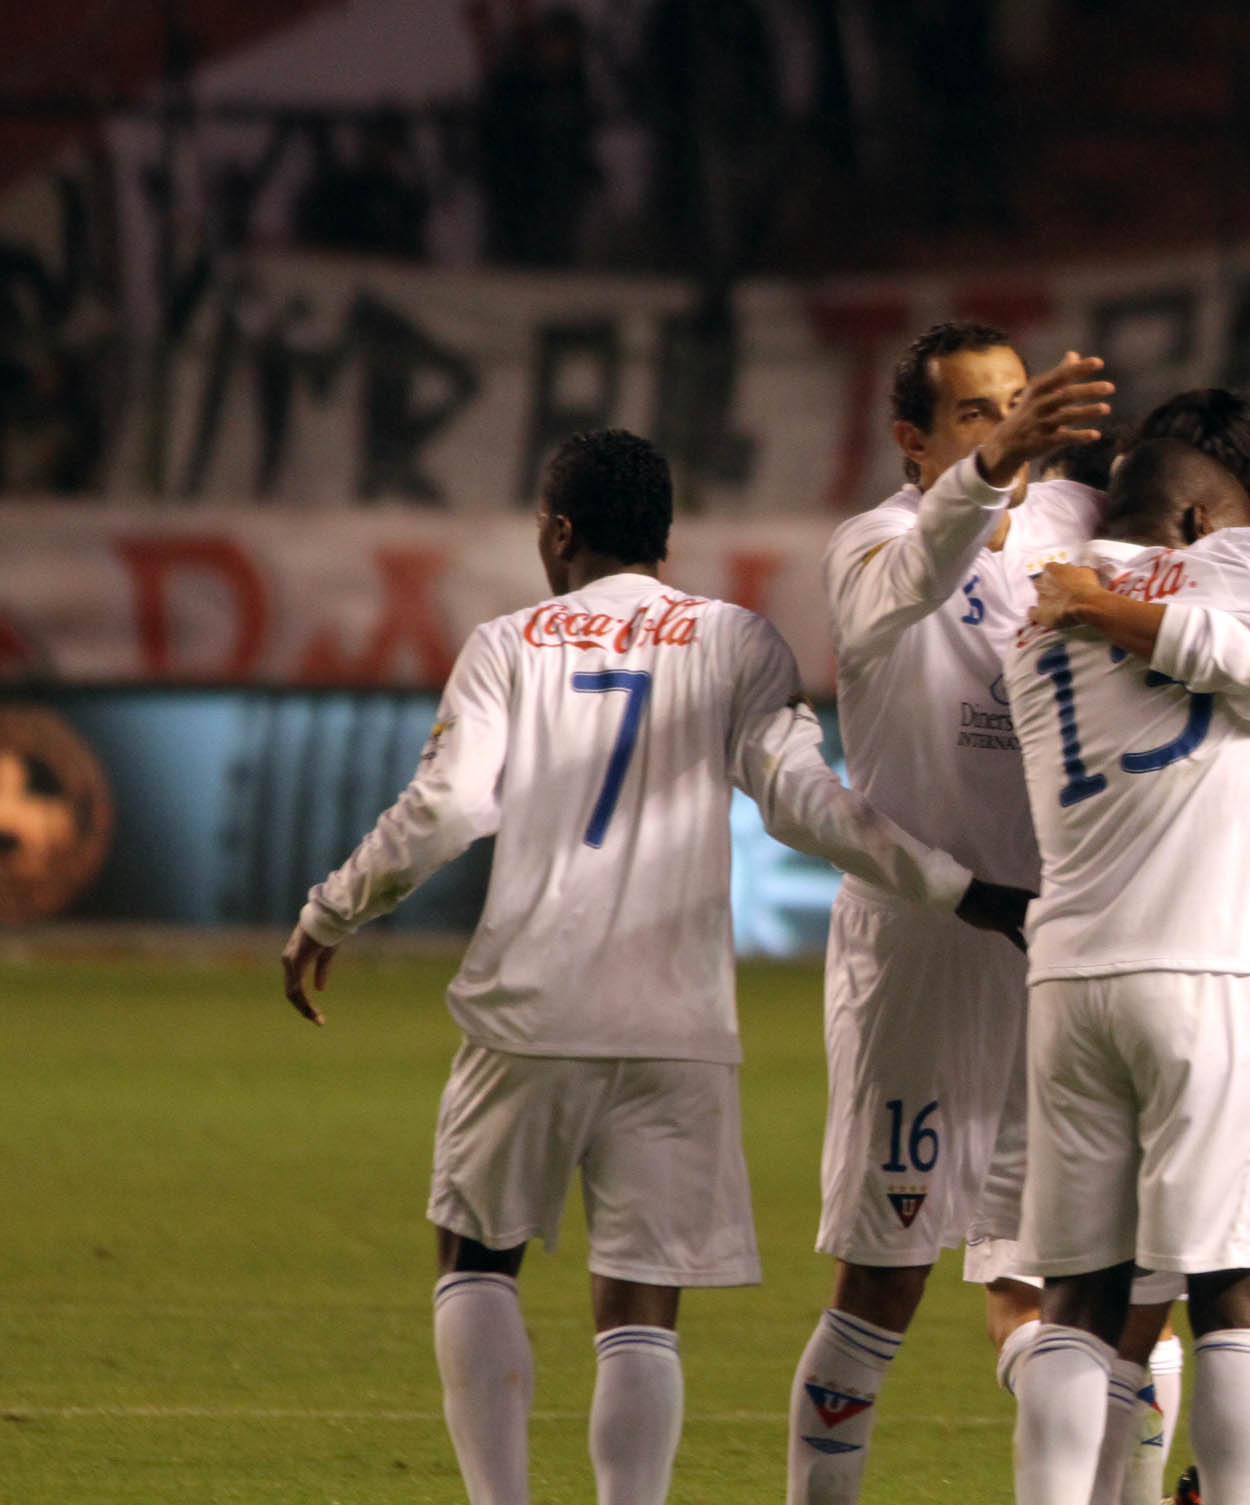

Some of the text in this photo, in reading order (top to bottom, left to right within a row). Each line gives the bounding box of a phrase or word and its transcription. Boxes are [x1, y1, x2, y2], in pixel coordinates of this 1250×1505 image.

[572, 669, 651, 849] 7
[957, 731, 1022, 751] INTERNA
[882, 1098, 939, 1173] 16
